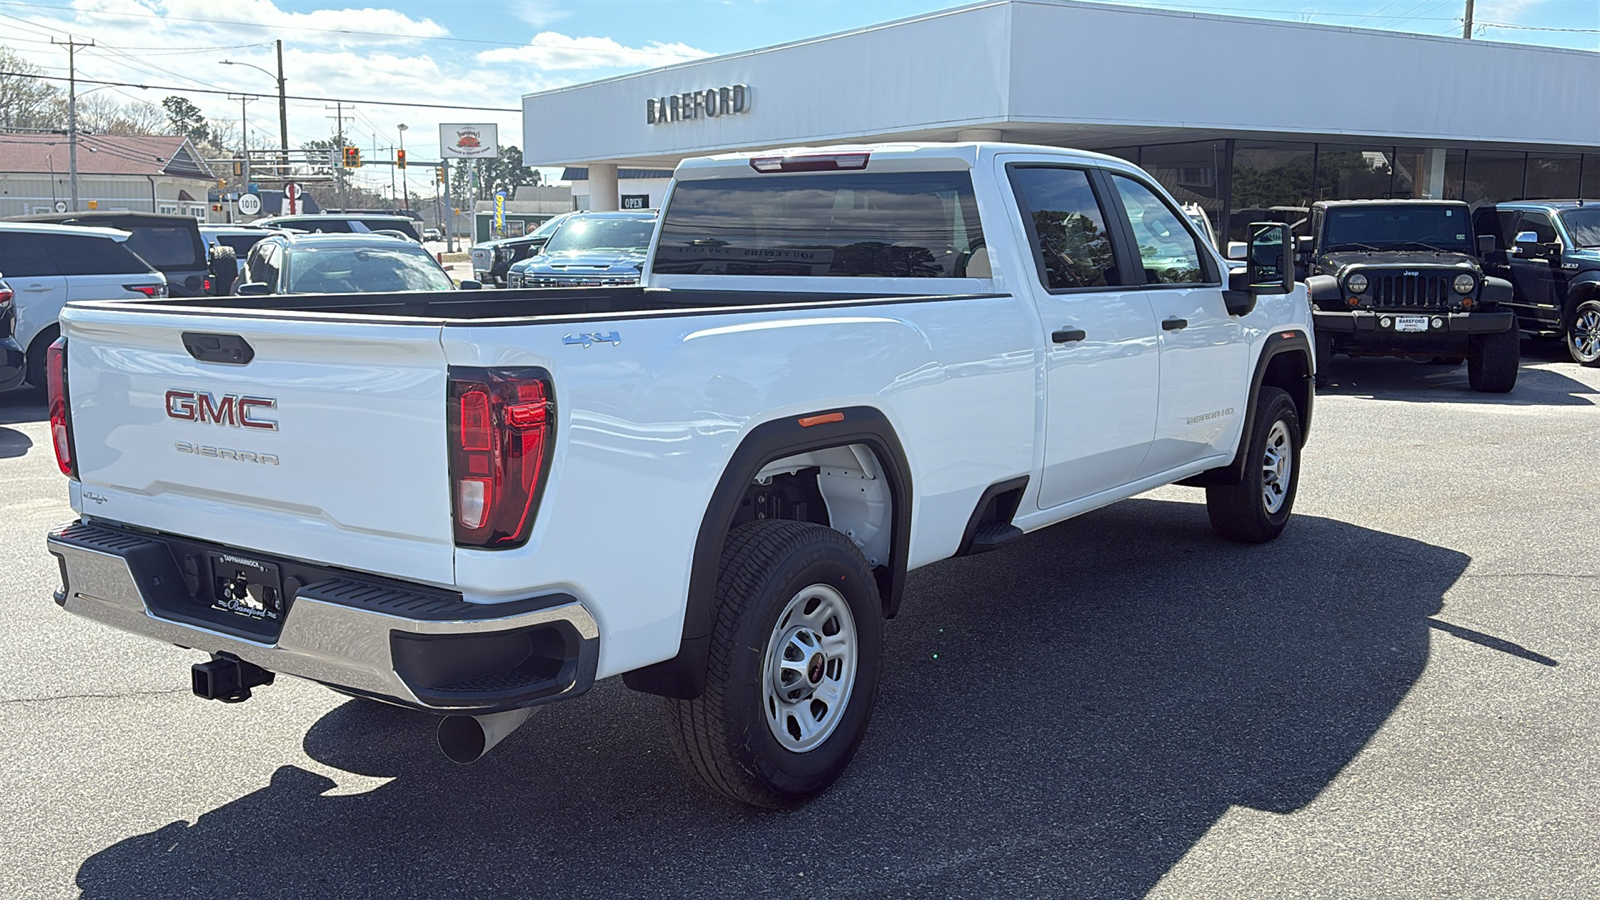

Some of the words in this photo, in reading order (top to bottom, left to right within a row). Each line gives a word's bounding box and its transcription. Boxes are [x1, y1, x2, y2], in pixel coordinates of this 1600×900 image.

[647, 84, 751, 124] BAREFORD
[241, 200, 258, 209] 1010
[625, 198, 643, 208] OPEN
[165, 387, 279, 431] GMC
[174, 441, 279, 465] SIERRA
[223, 554, 259, 568] TAPPAHANNOCK
[227, 599, 267, 617] Bareford
